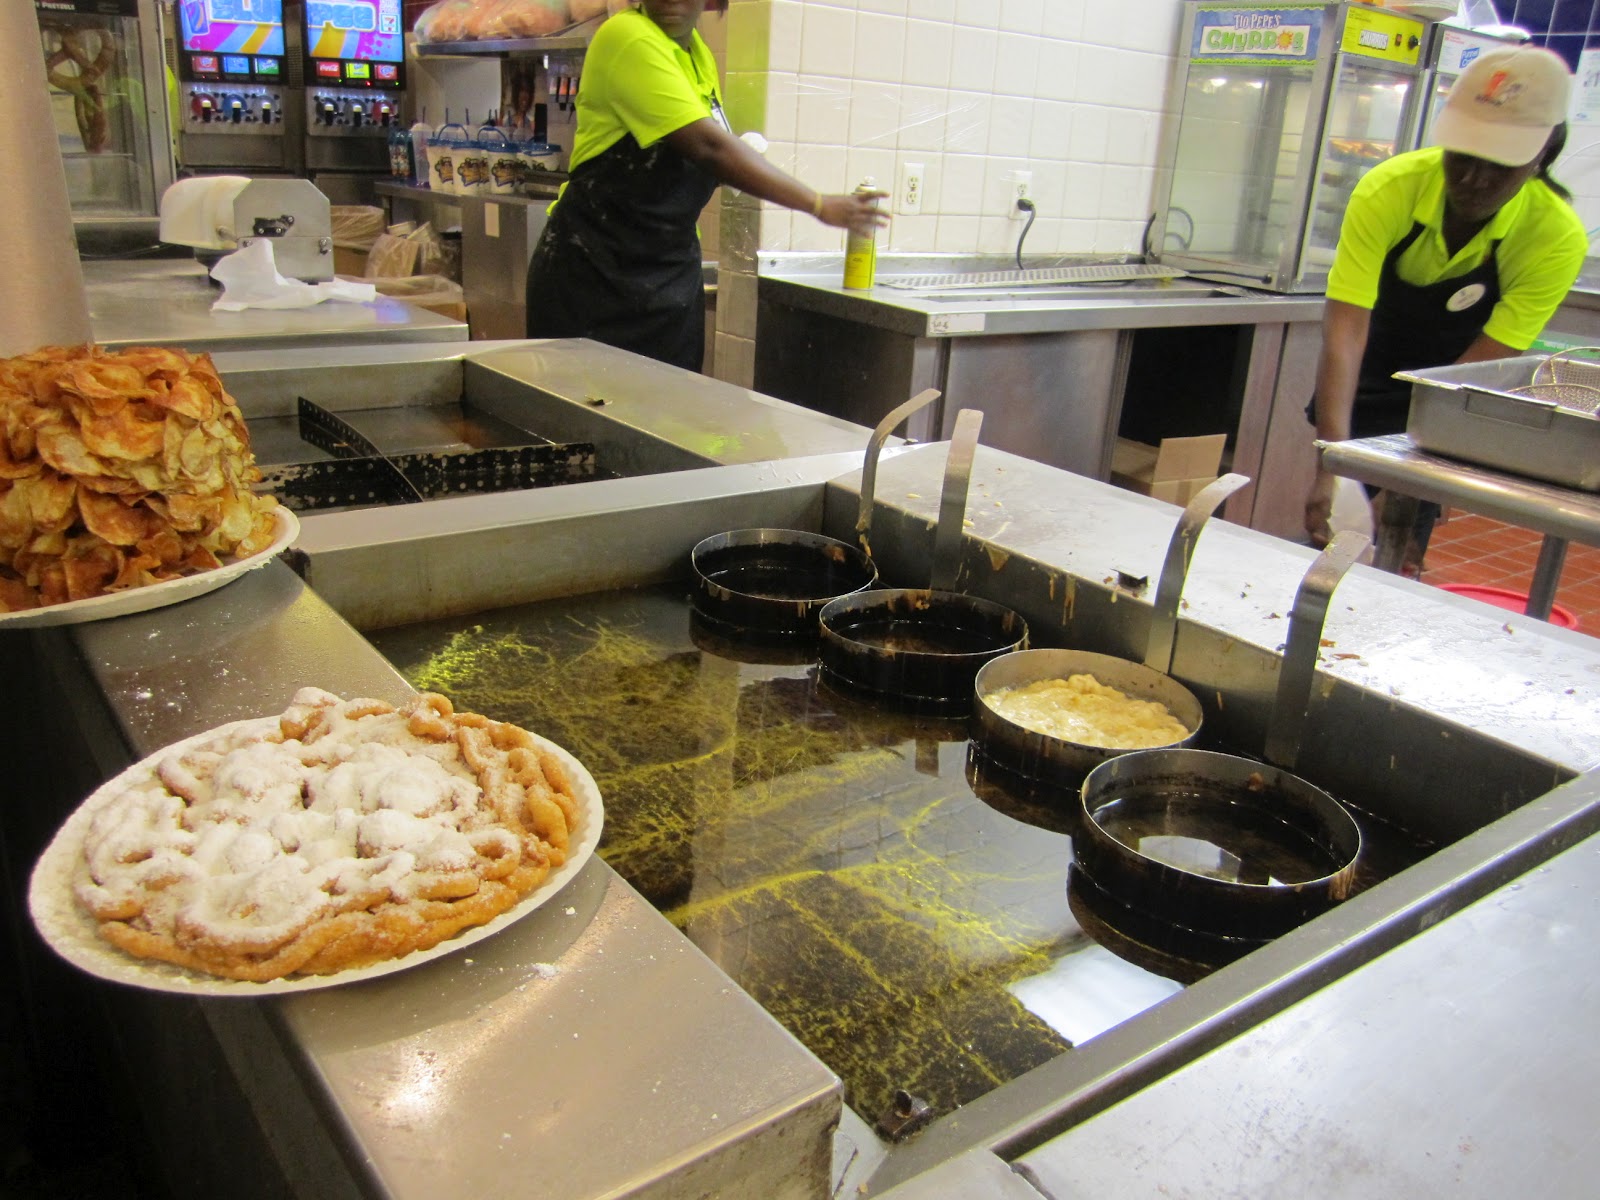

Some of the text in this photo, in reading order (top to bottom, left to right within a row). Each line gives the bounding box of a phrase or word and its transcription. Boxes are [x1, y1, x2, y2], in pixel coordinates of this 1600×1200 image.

[1234, 13, 1282, 29] TIO PEPE'S
[1206, 29, 1305, 52] CHURROS
